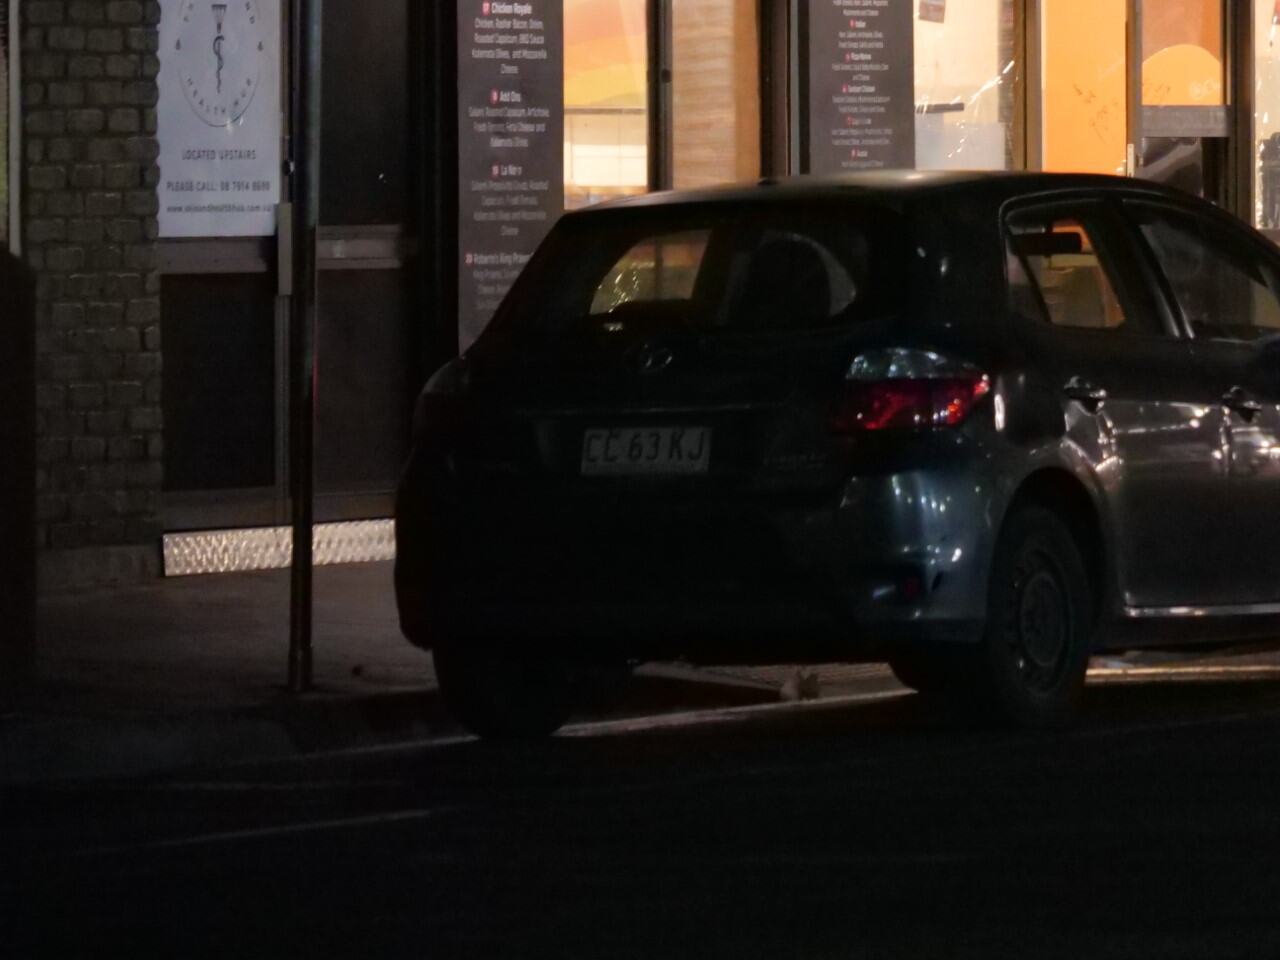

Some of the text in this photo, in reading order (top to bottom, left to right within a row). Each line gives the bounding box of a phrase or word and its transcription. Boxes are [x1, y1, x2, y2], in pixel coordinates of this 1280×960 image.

[182, 149, 256, 160] LOCATED UPSTAIRS
[166, 180, 194, 192] PLEASE
